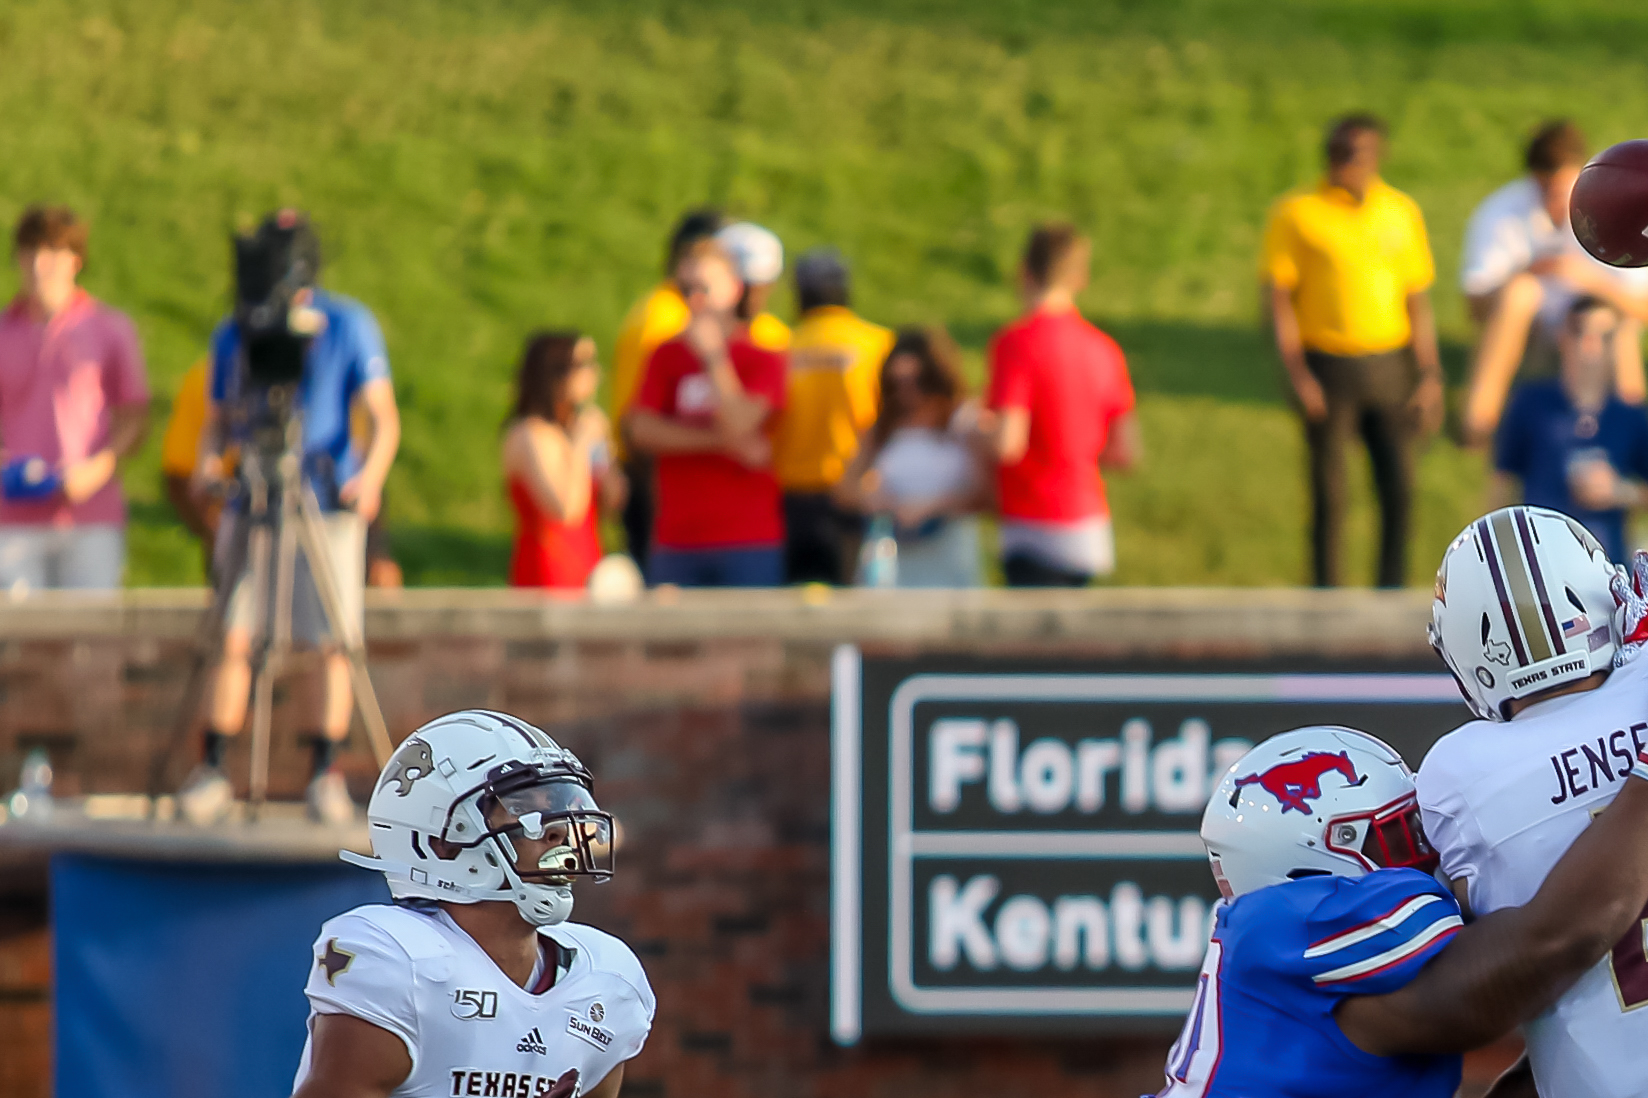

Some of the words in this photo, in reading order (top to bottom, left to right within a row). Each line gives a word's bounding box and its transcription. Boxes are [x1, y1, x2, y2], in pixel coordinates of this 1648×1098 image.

[1511, 670, 1548, 690] TEXAS
[1551, 659, 1586, 677] STATE
[928, 874, 1210, 972] Kentu
[569, 1016, 590, 1036] SUN
